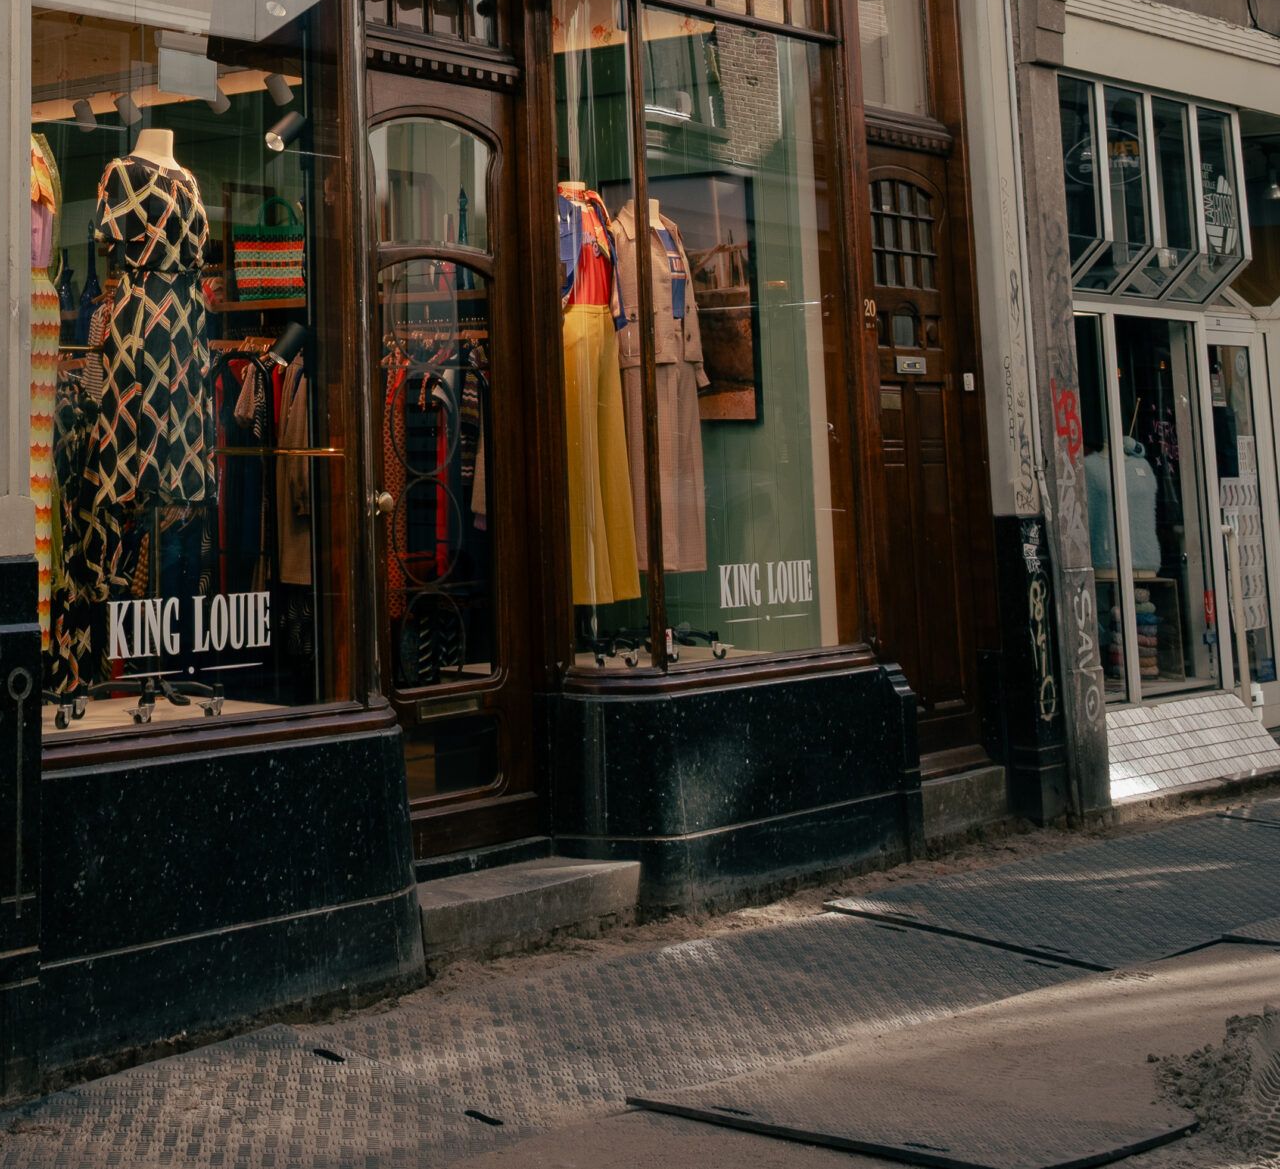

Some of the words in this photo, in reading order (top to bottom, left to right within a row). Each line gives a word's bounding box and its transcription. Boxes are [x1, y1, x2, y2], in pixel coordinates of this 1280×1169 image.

[864, 298, 876, 317] 20
[718, 562, 761, 609] KING
[766, 559, 813, 605] LOUIE
[107, 596, 181, 661] KING
[192, 591, 270, 653] LOUIE
